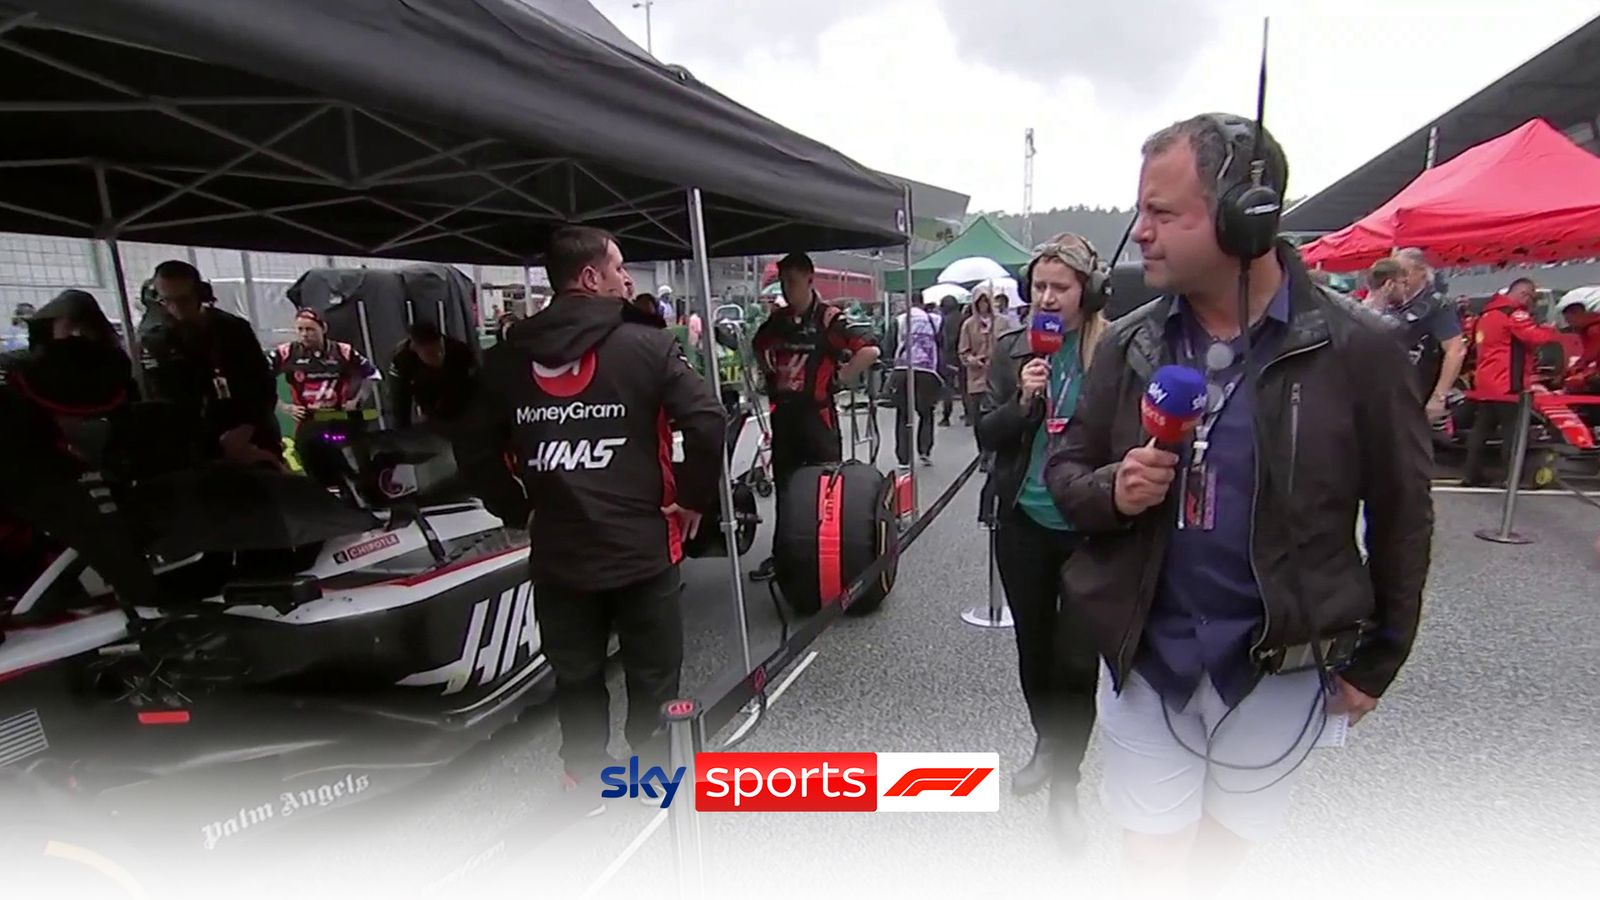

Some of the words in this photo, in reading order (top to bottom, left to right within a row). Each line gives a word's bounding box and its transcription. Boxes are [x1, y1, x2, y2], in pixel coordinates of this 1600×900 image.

[1148, 381, 1168, 404] sky
[516, 401, 626, 424] MoneyGram
[528, 437, 627, 472] HAAS
[349, 533, 399, 559] CHIPOTLE
[395, 579, 542, 696] HA
[202, 803, 274, 850] Palm
[280, 774, 369, 817] Angels
